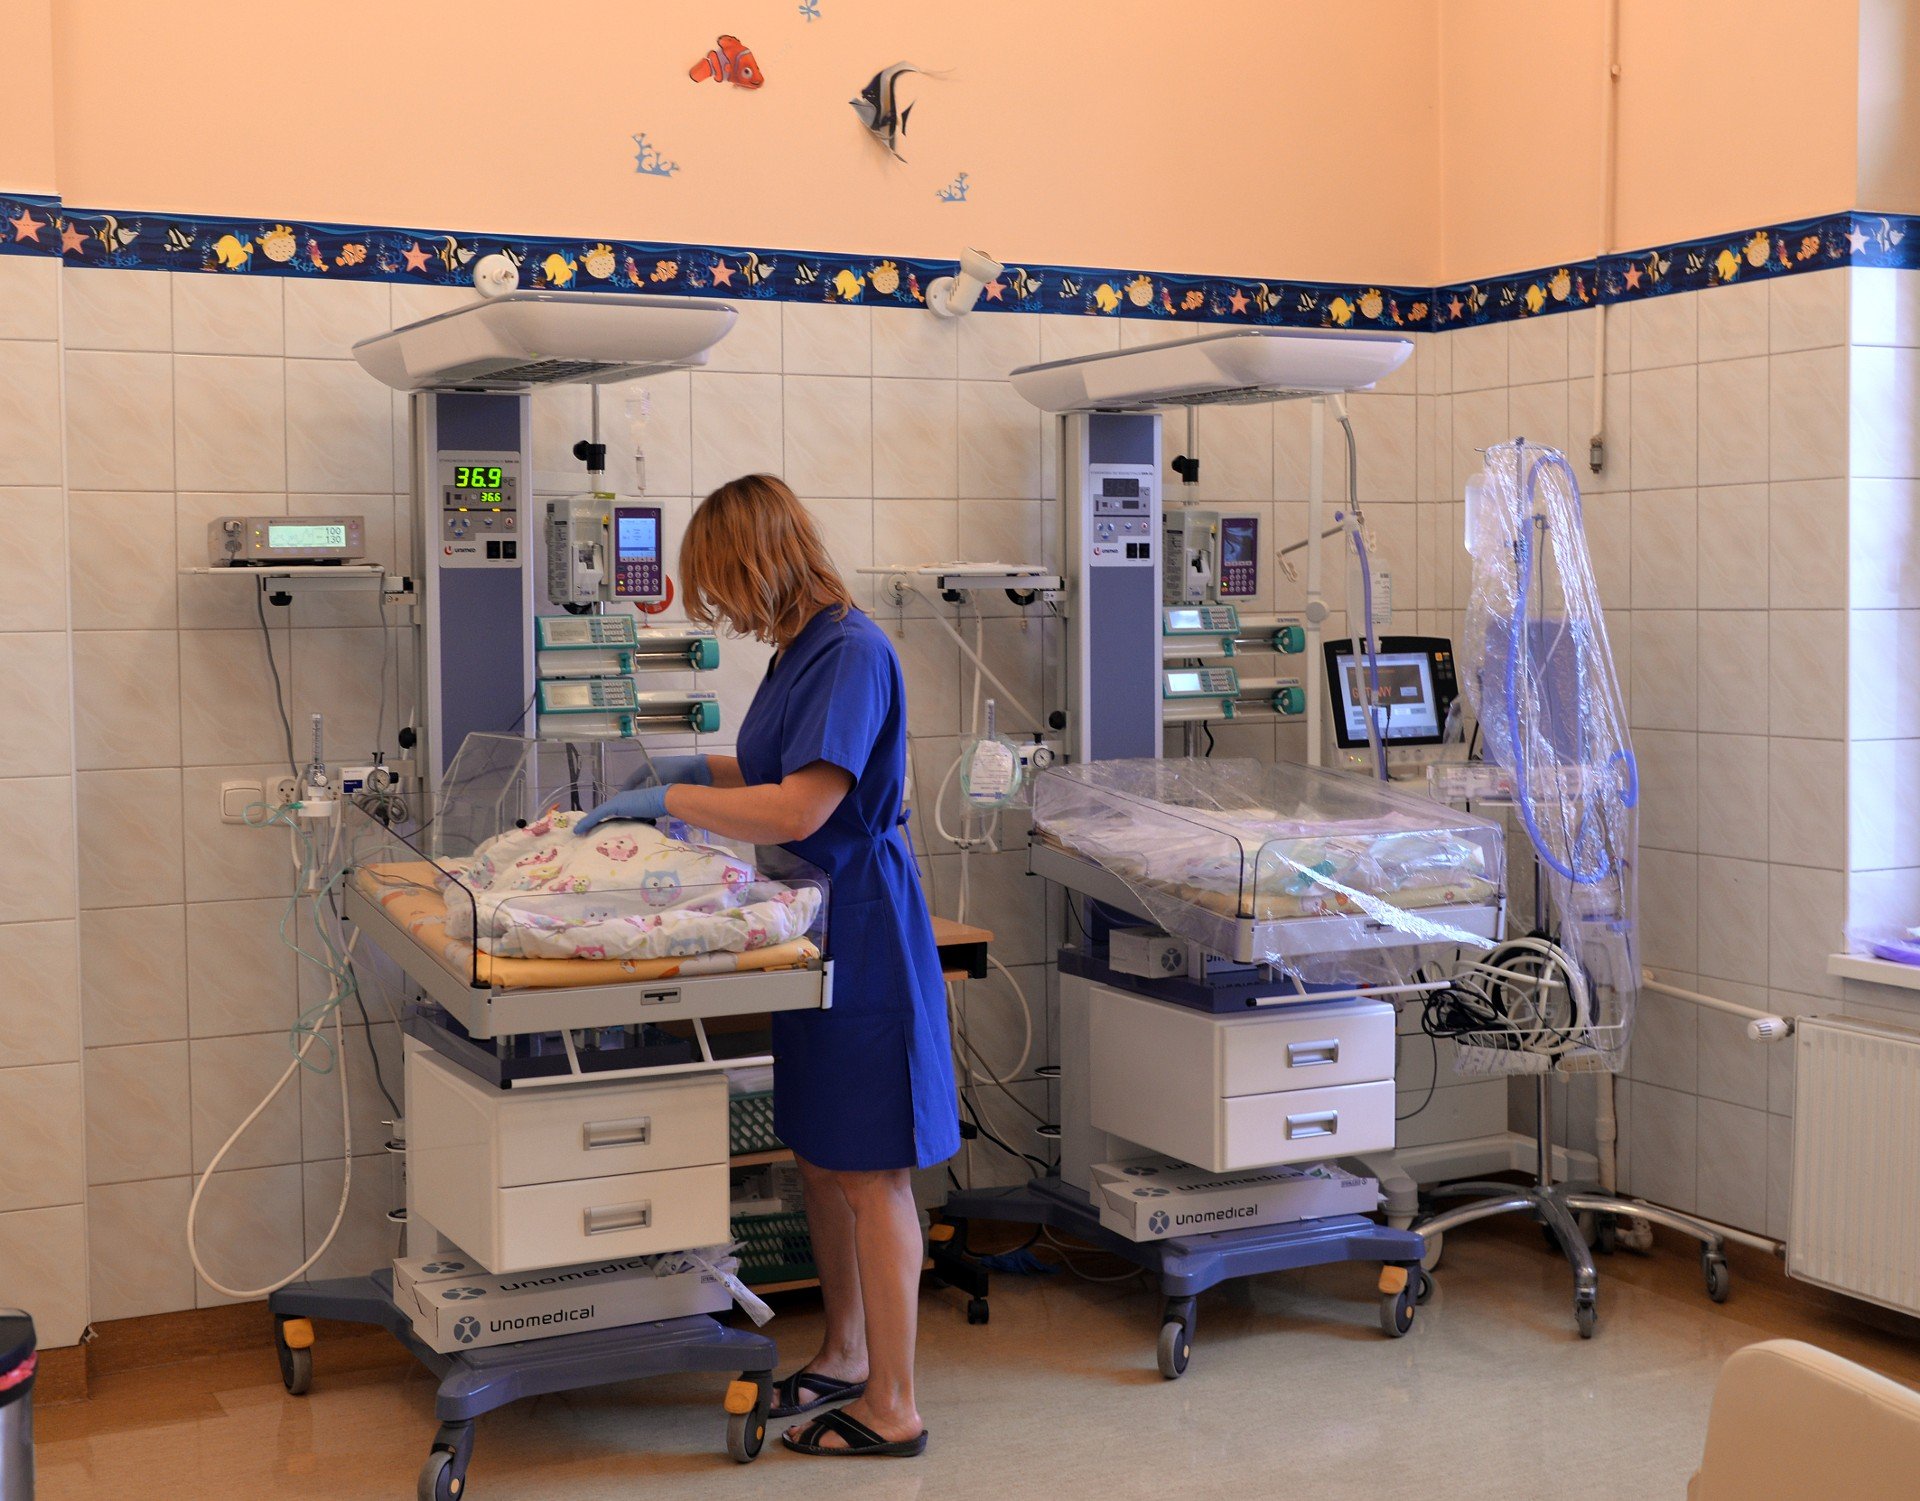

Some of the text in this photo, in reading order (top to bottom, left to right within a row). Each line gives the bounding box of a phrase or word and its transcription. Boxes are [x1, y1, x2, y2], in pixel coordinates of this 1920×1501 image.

[456, 467, 502, 487] 36.9
[481, 491, 501, 502] 36.6
[325, 527, 341, 535] 100
[325, 535, 341, 544] 130
[1176, 1171, 1305, 1191] Unomedica
[1176, 1204, 1258, 1226] Unomedical
[490, 1305, 595, 1332] Unomedical
